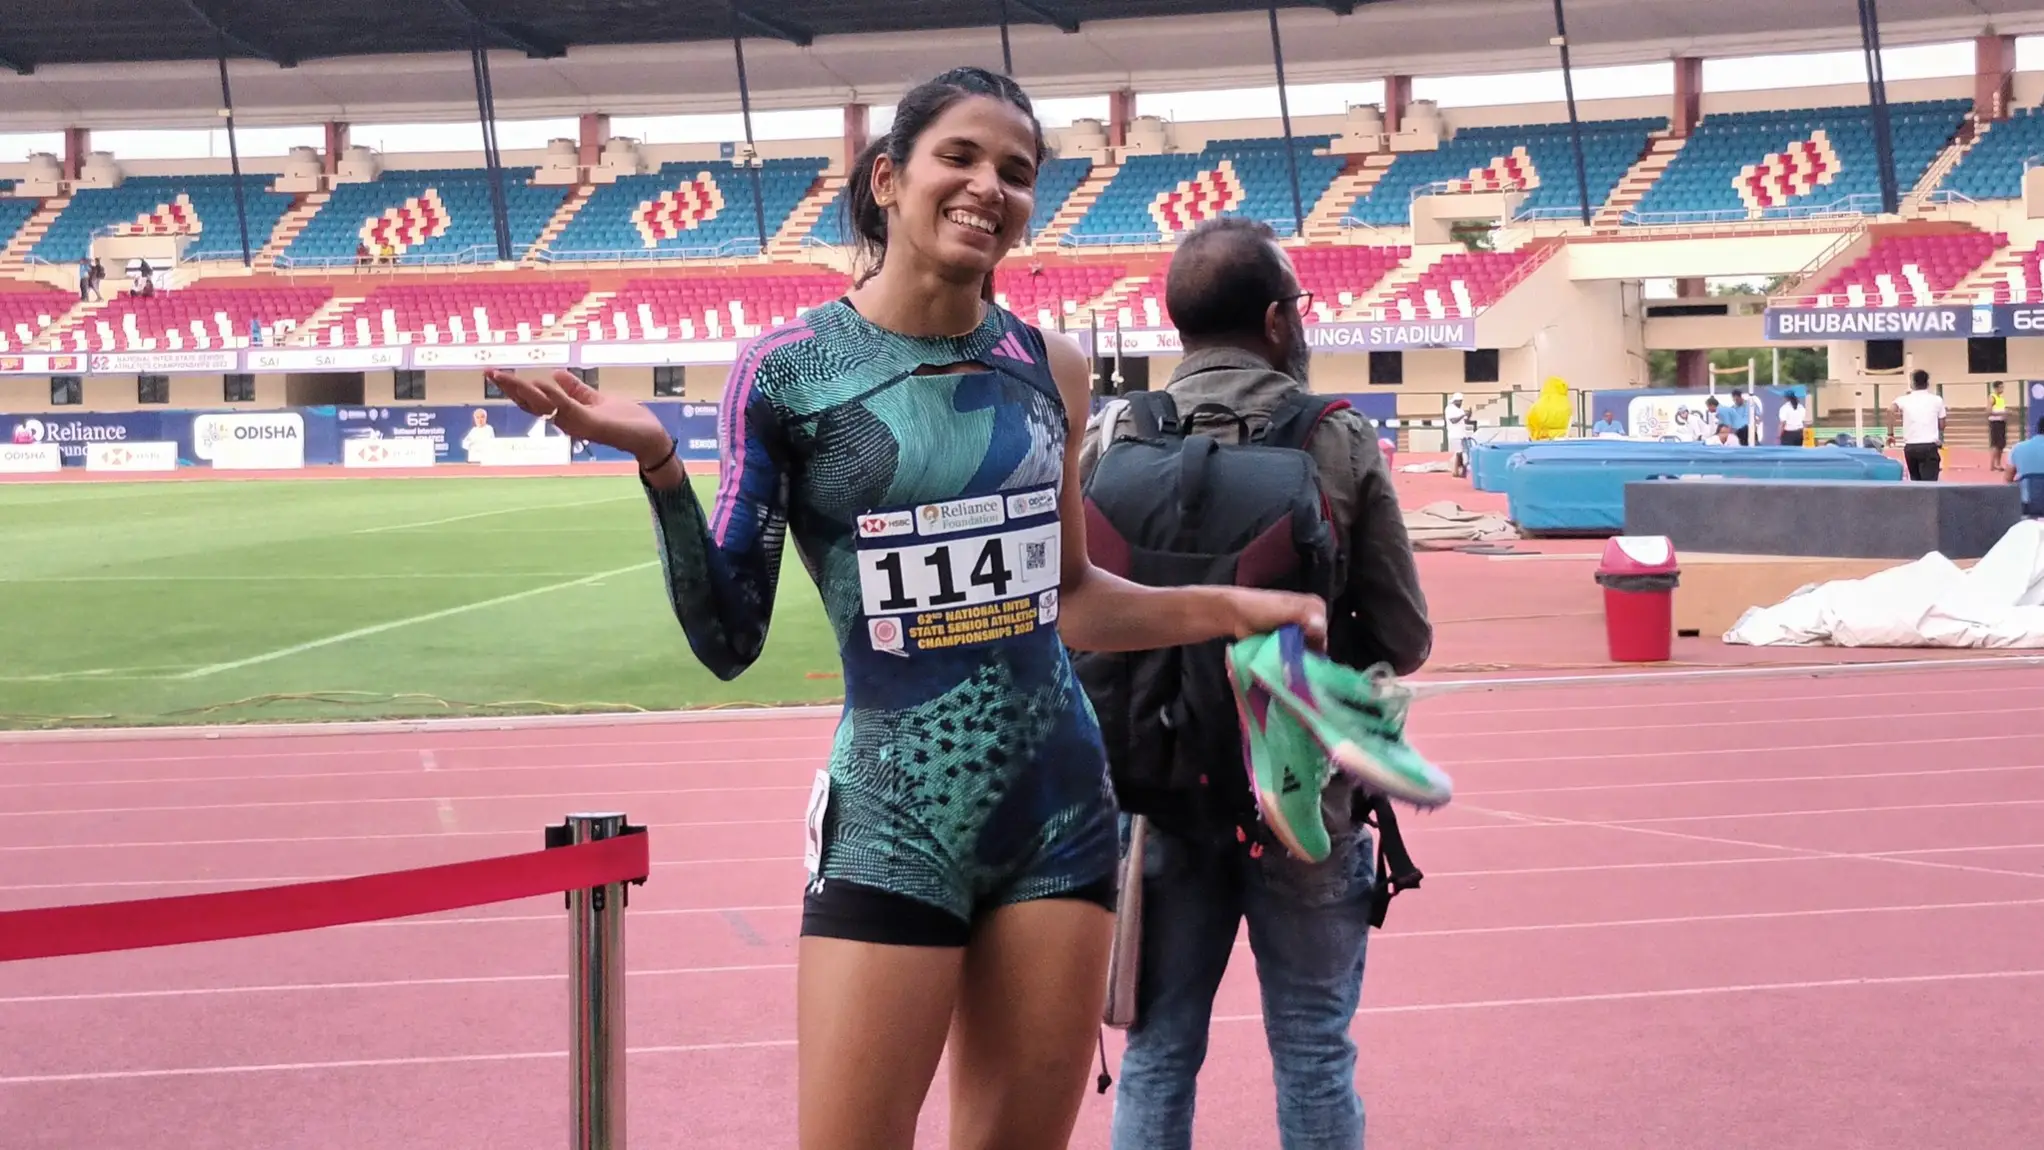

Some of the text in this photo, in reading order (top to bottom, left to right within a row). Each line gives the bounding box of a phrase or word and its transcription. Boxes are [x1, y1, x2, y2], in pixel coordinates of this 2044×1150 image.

[1778, 311, 1956, 334] BHUBANESWAR
[1103, 335, 1138, 348] Nco
[1155, 334, 1183, 347] Nel
[1304, 324, 1463, 346] LINGA STADIUM
[45, 422, 127, 442] Reliance
[234, 426, 297, 440] ODISHA
[4, 451, 46, 460] ODISHA
[940, 500, 998, 519] Reliance
[888, 518, 911, 528] HSBC
[942, 513, 999, 529] Foundation
[875, 538, 1012, 611] 114
[945, 604, 1000, 622] NATIONAL
[1002, 598, 1031, 612] INTER
[909, 608, 1037, 638] STATE SENIOR ATHLETICS
[917, 626, 1012, 649] CHAMPIONSHIPS
